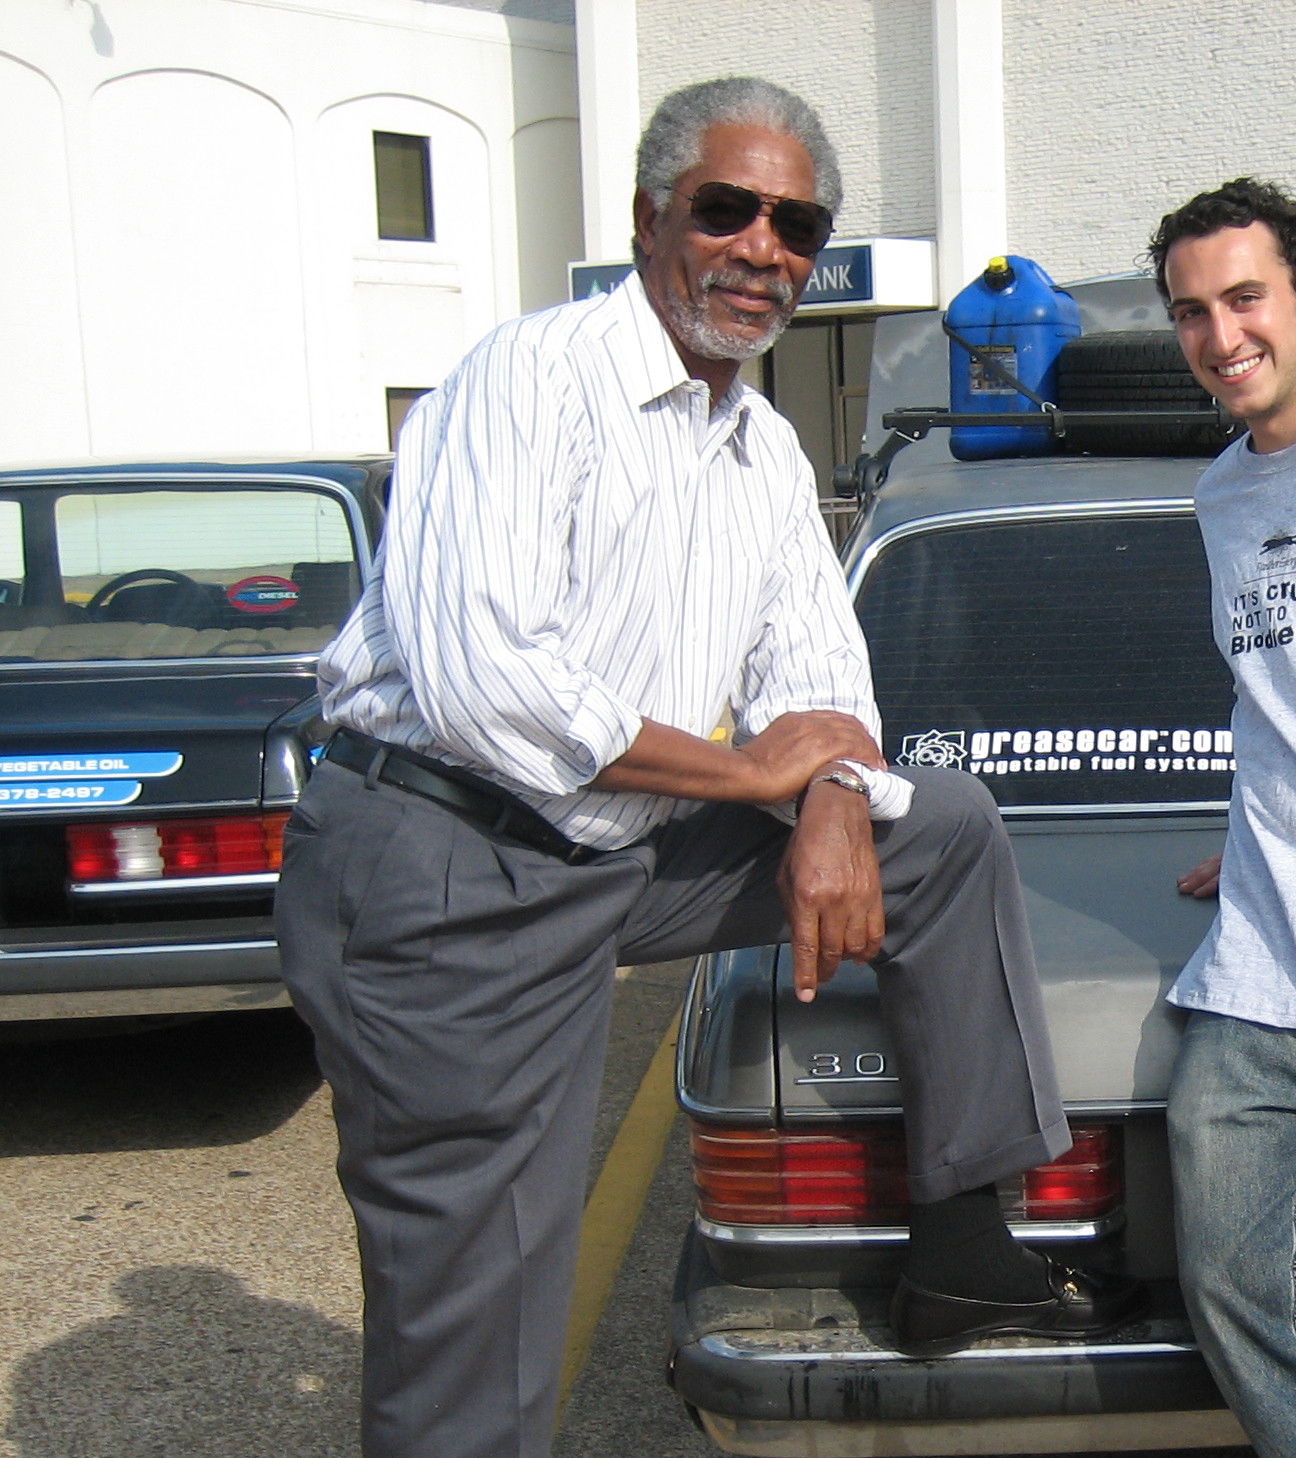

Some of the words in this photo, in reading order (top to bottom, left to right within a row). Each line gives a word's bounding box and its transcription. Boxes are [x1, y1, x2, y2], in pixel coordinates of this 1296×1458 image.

[806, 264, 853, 292] ANK
[1233, 590, 1259, 612] IT'S
[1232, 610, 1262, 632] NOT
[1266, 605, 1287, 623] TO
[0, 760, 98, 773] EGETABLE
[100, 759, 130, 771] OIL
[969, 756, 1081, 775] vegetable
[1091, 755, 1136, 771] fuel
